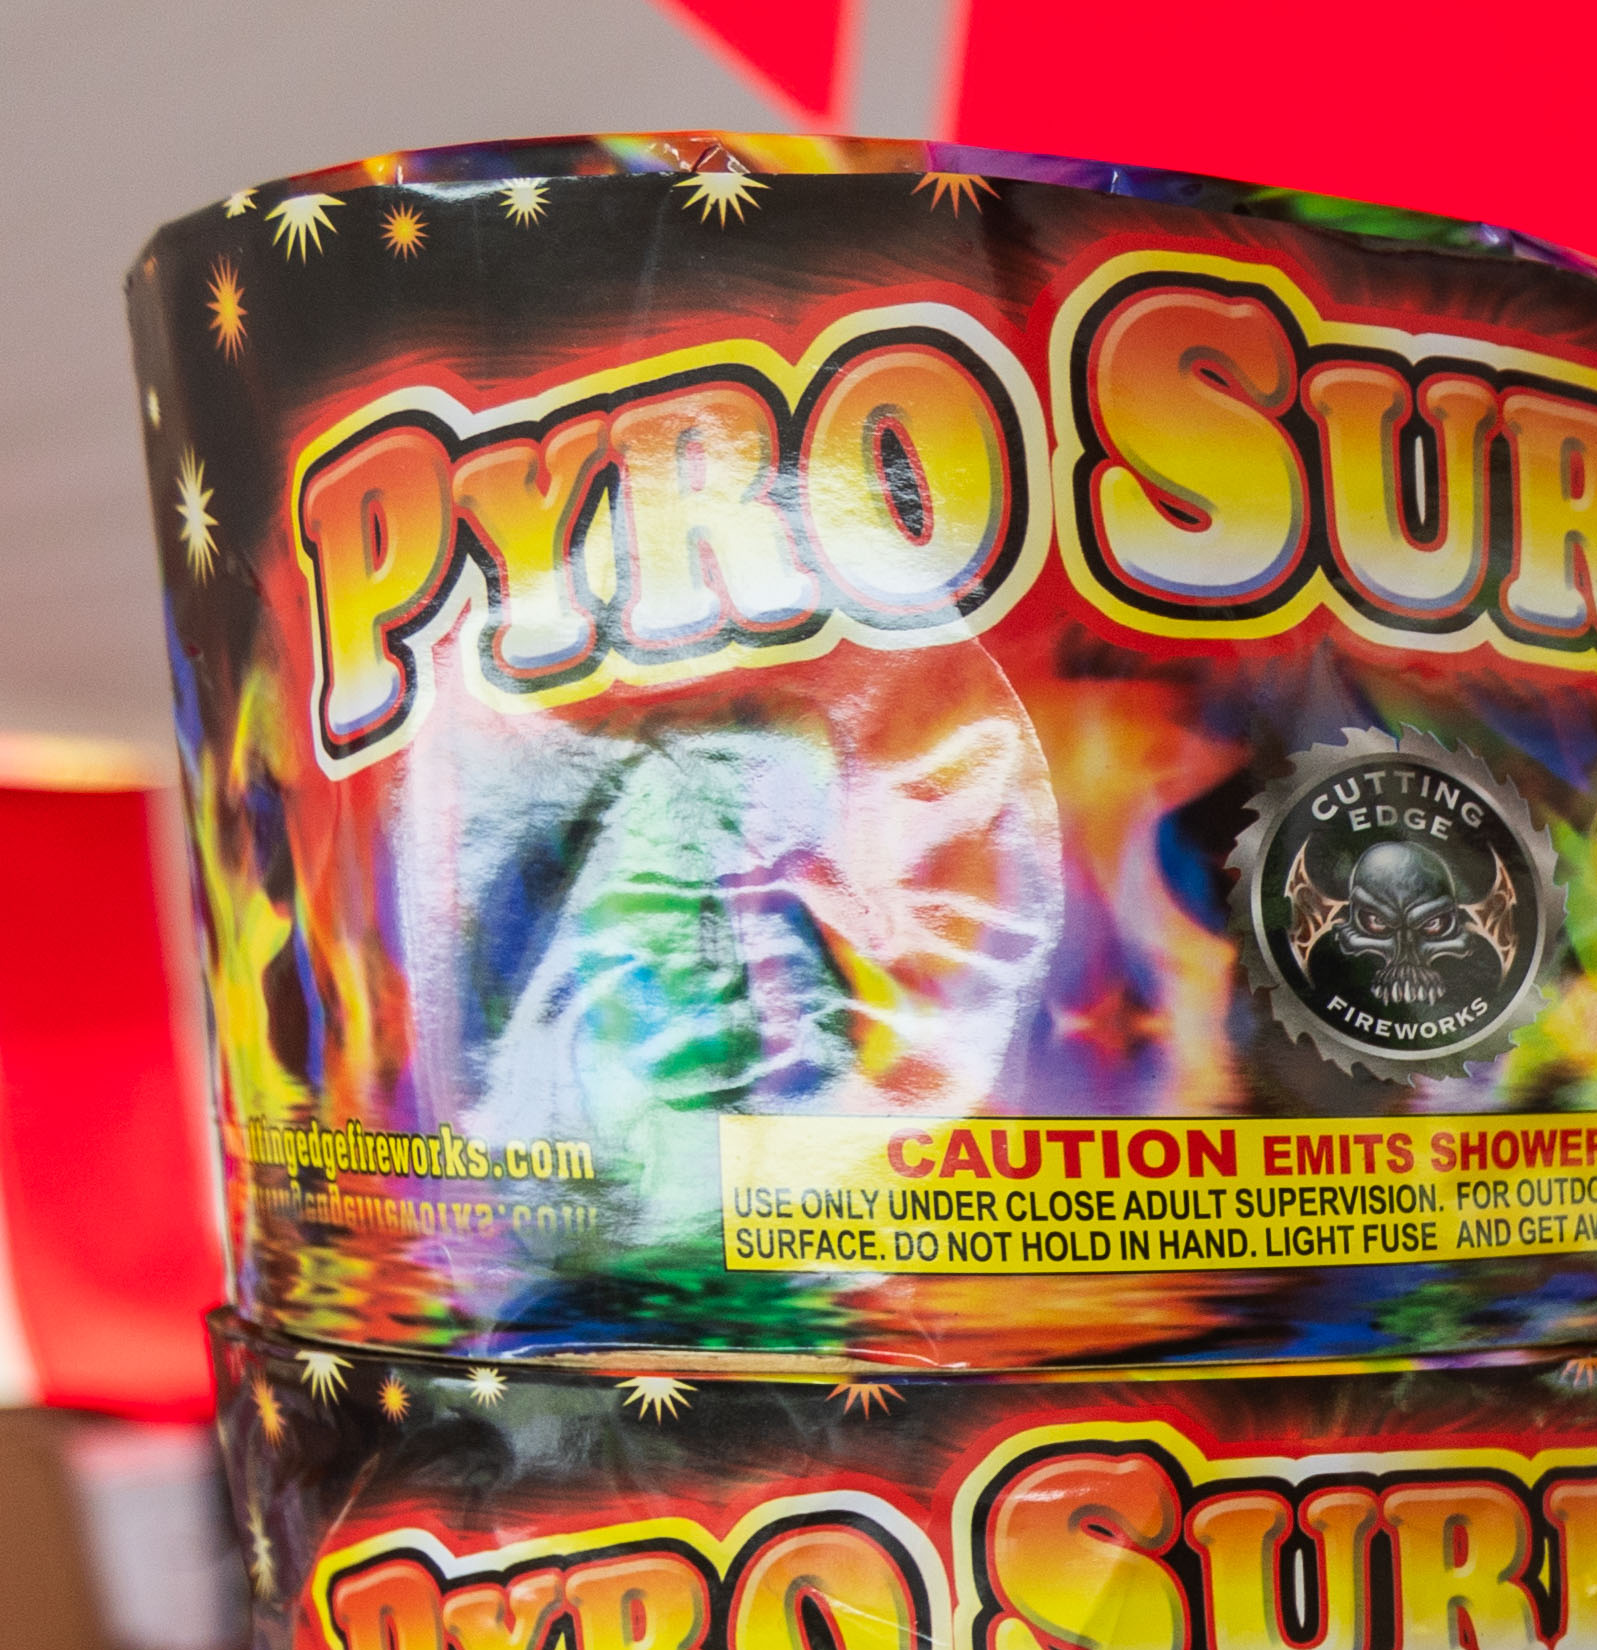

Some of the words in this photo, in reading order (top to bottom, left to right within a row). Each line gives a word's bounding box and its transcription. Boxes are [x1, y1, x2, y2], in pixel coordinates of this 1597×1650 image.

[298, 324, 1028, 762] PYRO
[1310, 770, 1486, 829] CUTTING
[1349, 804, 1453, 841] EDGE
[1326, 994, 1489, 1040] FIREWORKS
[886, 1127, 1238, 1180] CAUTION
[1263, 1132, 1414, 1176] EMITS
[734, 1186, 792, 1220] USE
[801, 1187, 880, 1221] ONLY
[887, 1188, 998, 1222] UNDER
[1005, 1189, 1117, 1222] CLOSE
[1124, 1188, 1229, 1221] ADULT
[1235, 1184, 1444, 1220] SUPERVISION.
[1457, 1180, 1510, 1210] FOR
[735, 1228, 886, 1261] SURFACE.
[894, 1231, 938, 1262] DO
[947, 1231, 1011, 1263] NOT
[1022, 1230, 1111, 1262] HOLD
[1120, 1229, 1149, 1261] IN
[1158, 1227, 1257, 1260] HAND.
[1265, 1225, 1354, 1257] LIGHT
[1363, 1222, 1438, 1253] FUSE
[1457, 1218, 1510, 1249] AND
[1519, 1214, 1568, 1245] GET
